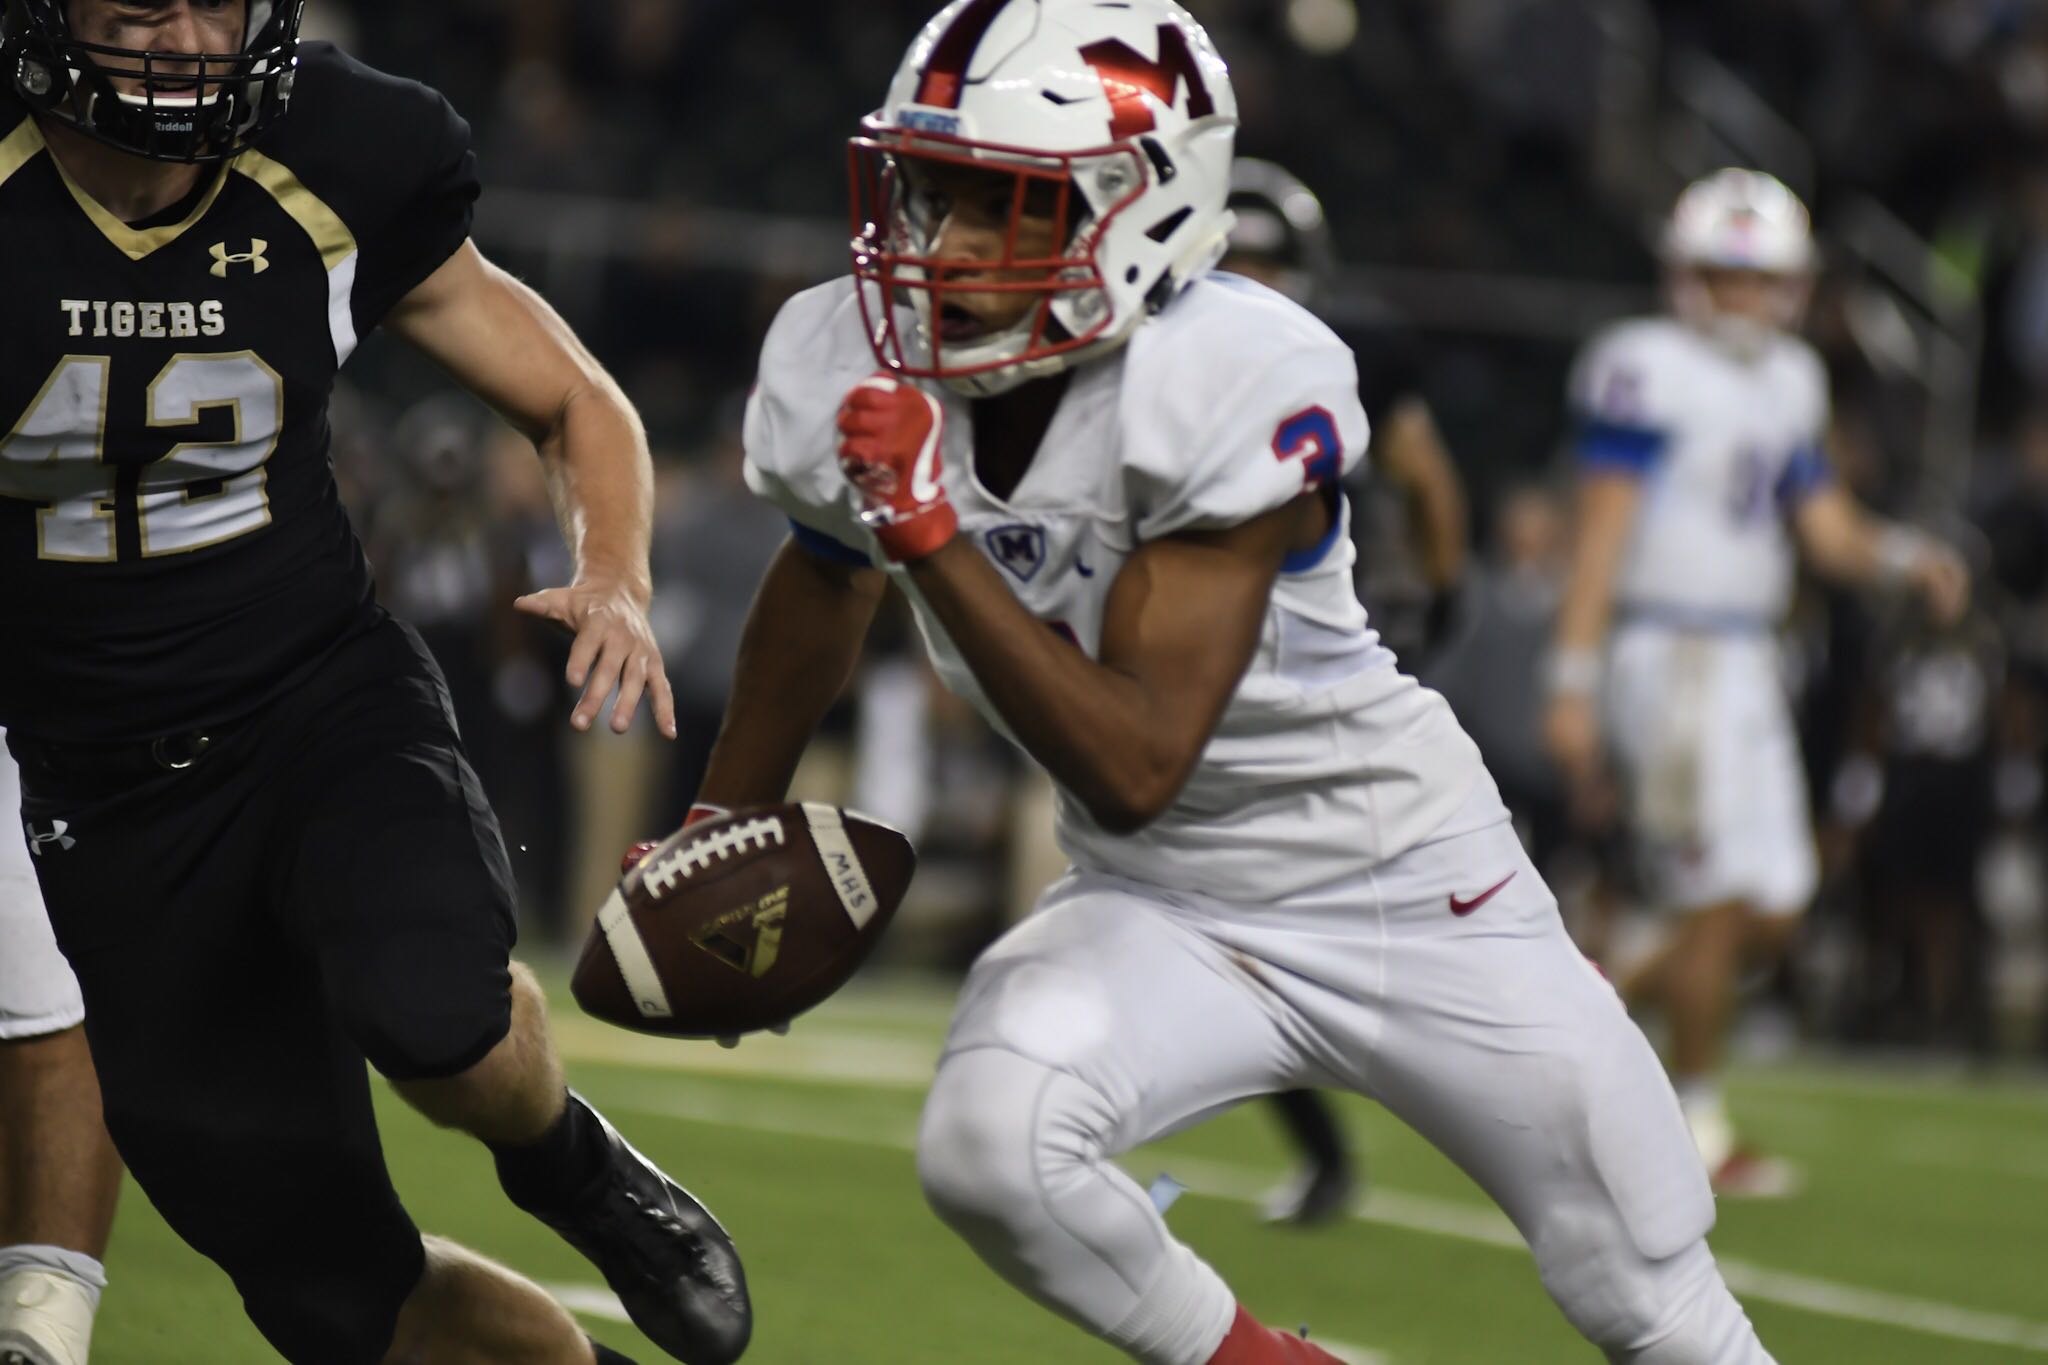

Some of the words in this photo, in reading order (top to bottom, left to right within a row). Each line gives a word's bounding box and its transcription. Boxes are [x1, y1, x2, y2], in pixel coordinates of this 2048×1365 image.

[154, 121, 193, 132] Riddell
[61, 299, 226, 338] TIGERS
[0, 349, 284, 563] 42
[997, 531, 1038, 564] M
[827, 852, 867, 910] MHS
